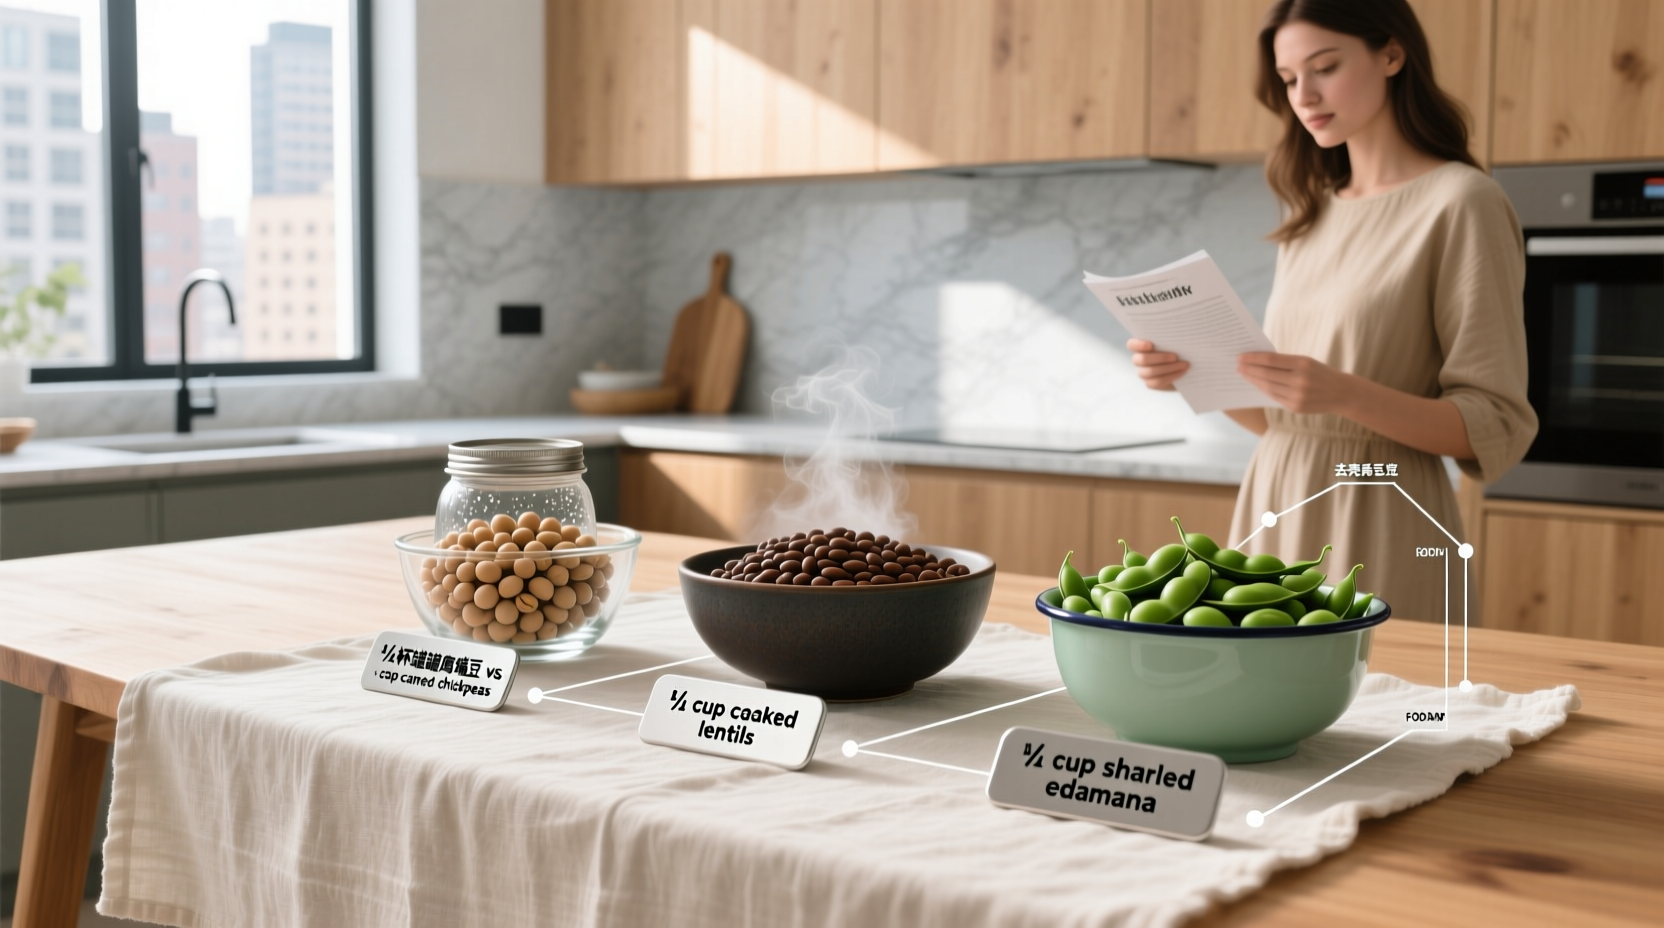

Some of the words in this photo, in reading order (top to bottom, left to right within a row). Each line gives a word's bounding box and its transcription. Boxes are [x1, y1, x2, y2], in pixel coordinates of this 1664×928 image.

[692, 699, 726, 720] cup
[697, 720, 755, 745] lentils
[1052, 754, 1096, 778] cup
[1102, 757, 1196, 791] sharled
[1045, 778, 1157, 813] edamana
